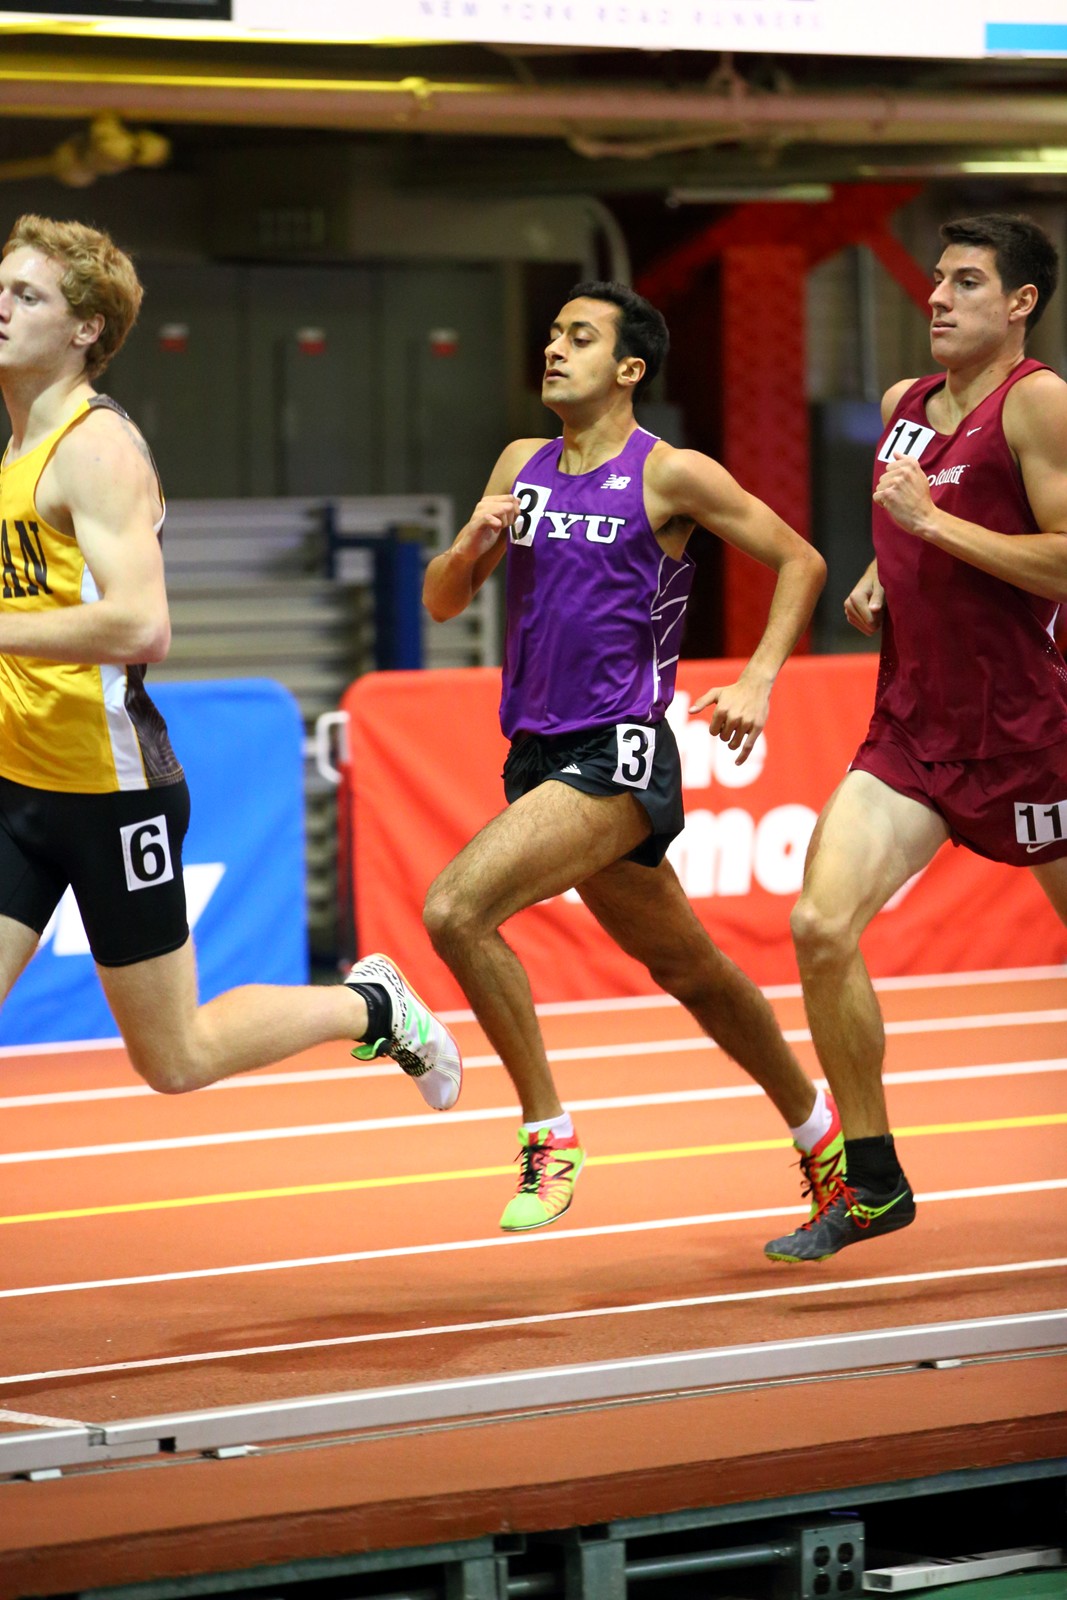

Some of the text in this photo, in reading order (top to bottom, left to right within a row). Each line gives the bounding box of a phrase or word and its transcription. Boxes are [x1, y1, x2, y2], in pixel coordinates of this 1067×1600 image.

[417, 0, 822, 30] NEW YORK ROAD RUNNERS
[884, 421, 923, 460] 11
[512, 487, 539, 541] 3
[543, 509, 627, 545] YU
[621, 728, 649, 783] 3
[1018, 804, 1063, 842] 11
[129, 823, 166, 883] 6
